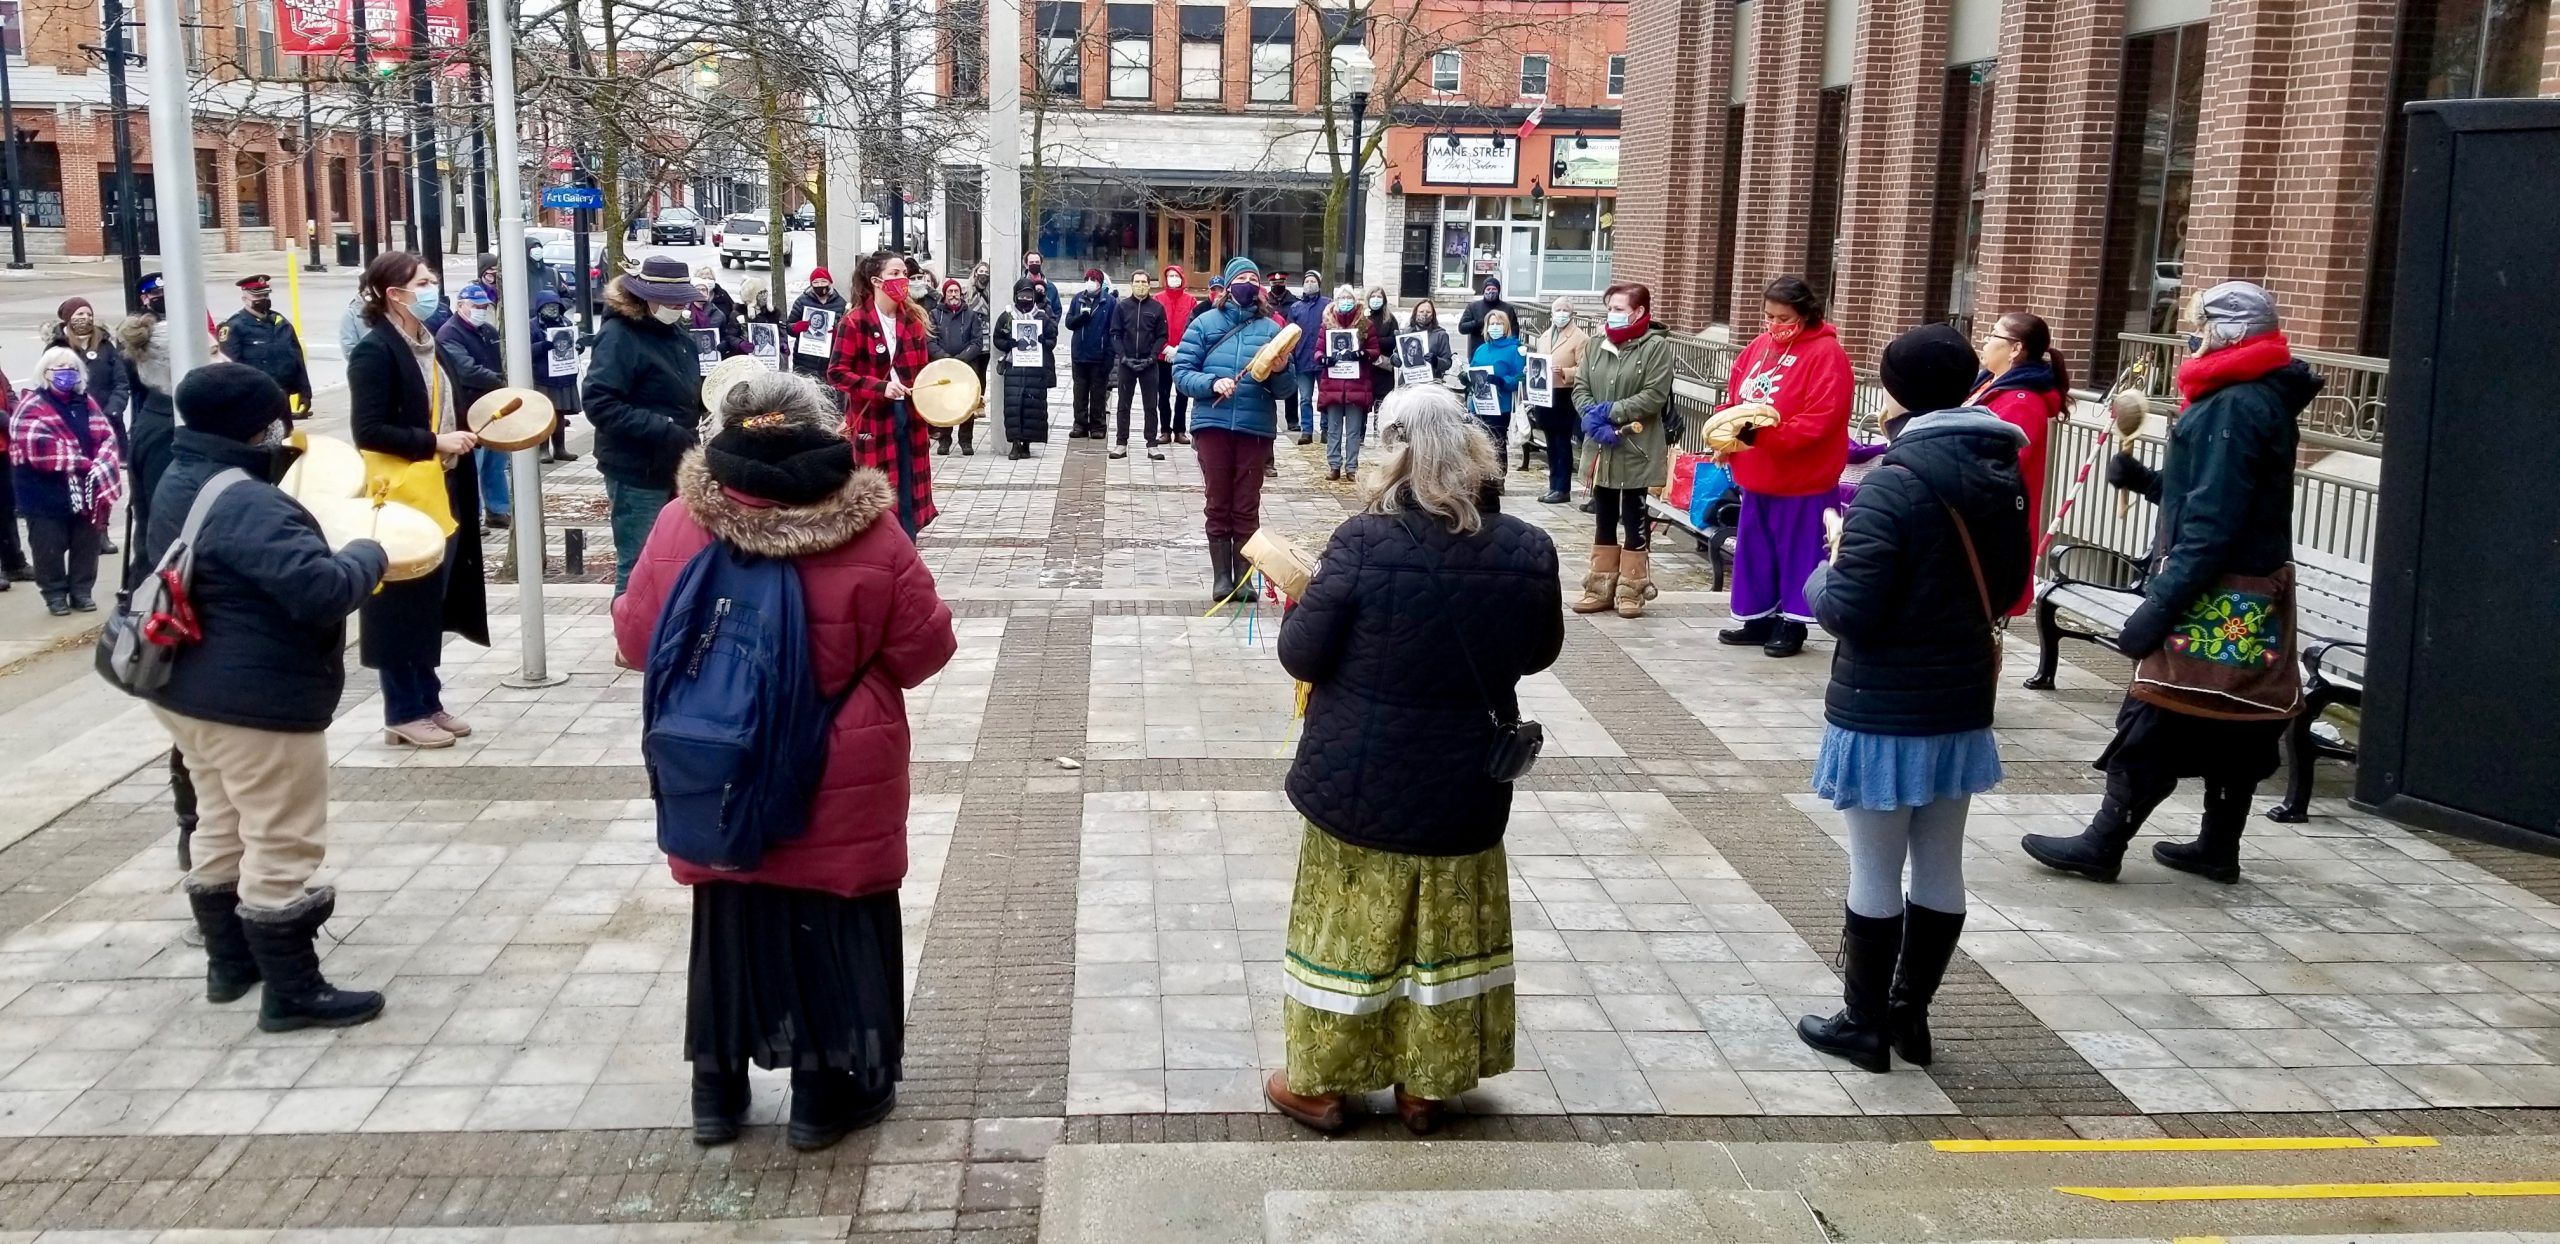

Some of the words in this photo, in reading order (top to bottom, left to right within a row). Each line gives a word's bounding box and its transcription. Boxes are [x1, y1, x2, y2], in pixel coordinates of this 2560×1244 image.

[301, 8, 328, 21] DAY
[427, 26, 460, 38] CKEY
[1432, 146, 1467, 157] MANE
[1473, 147, 1511, 158] STREET
[547, 193, 562, 203] Art
[563, 193, 594, 204] Gallery
